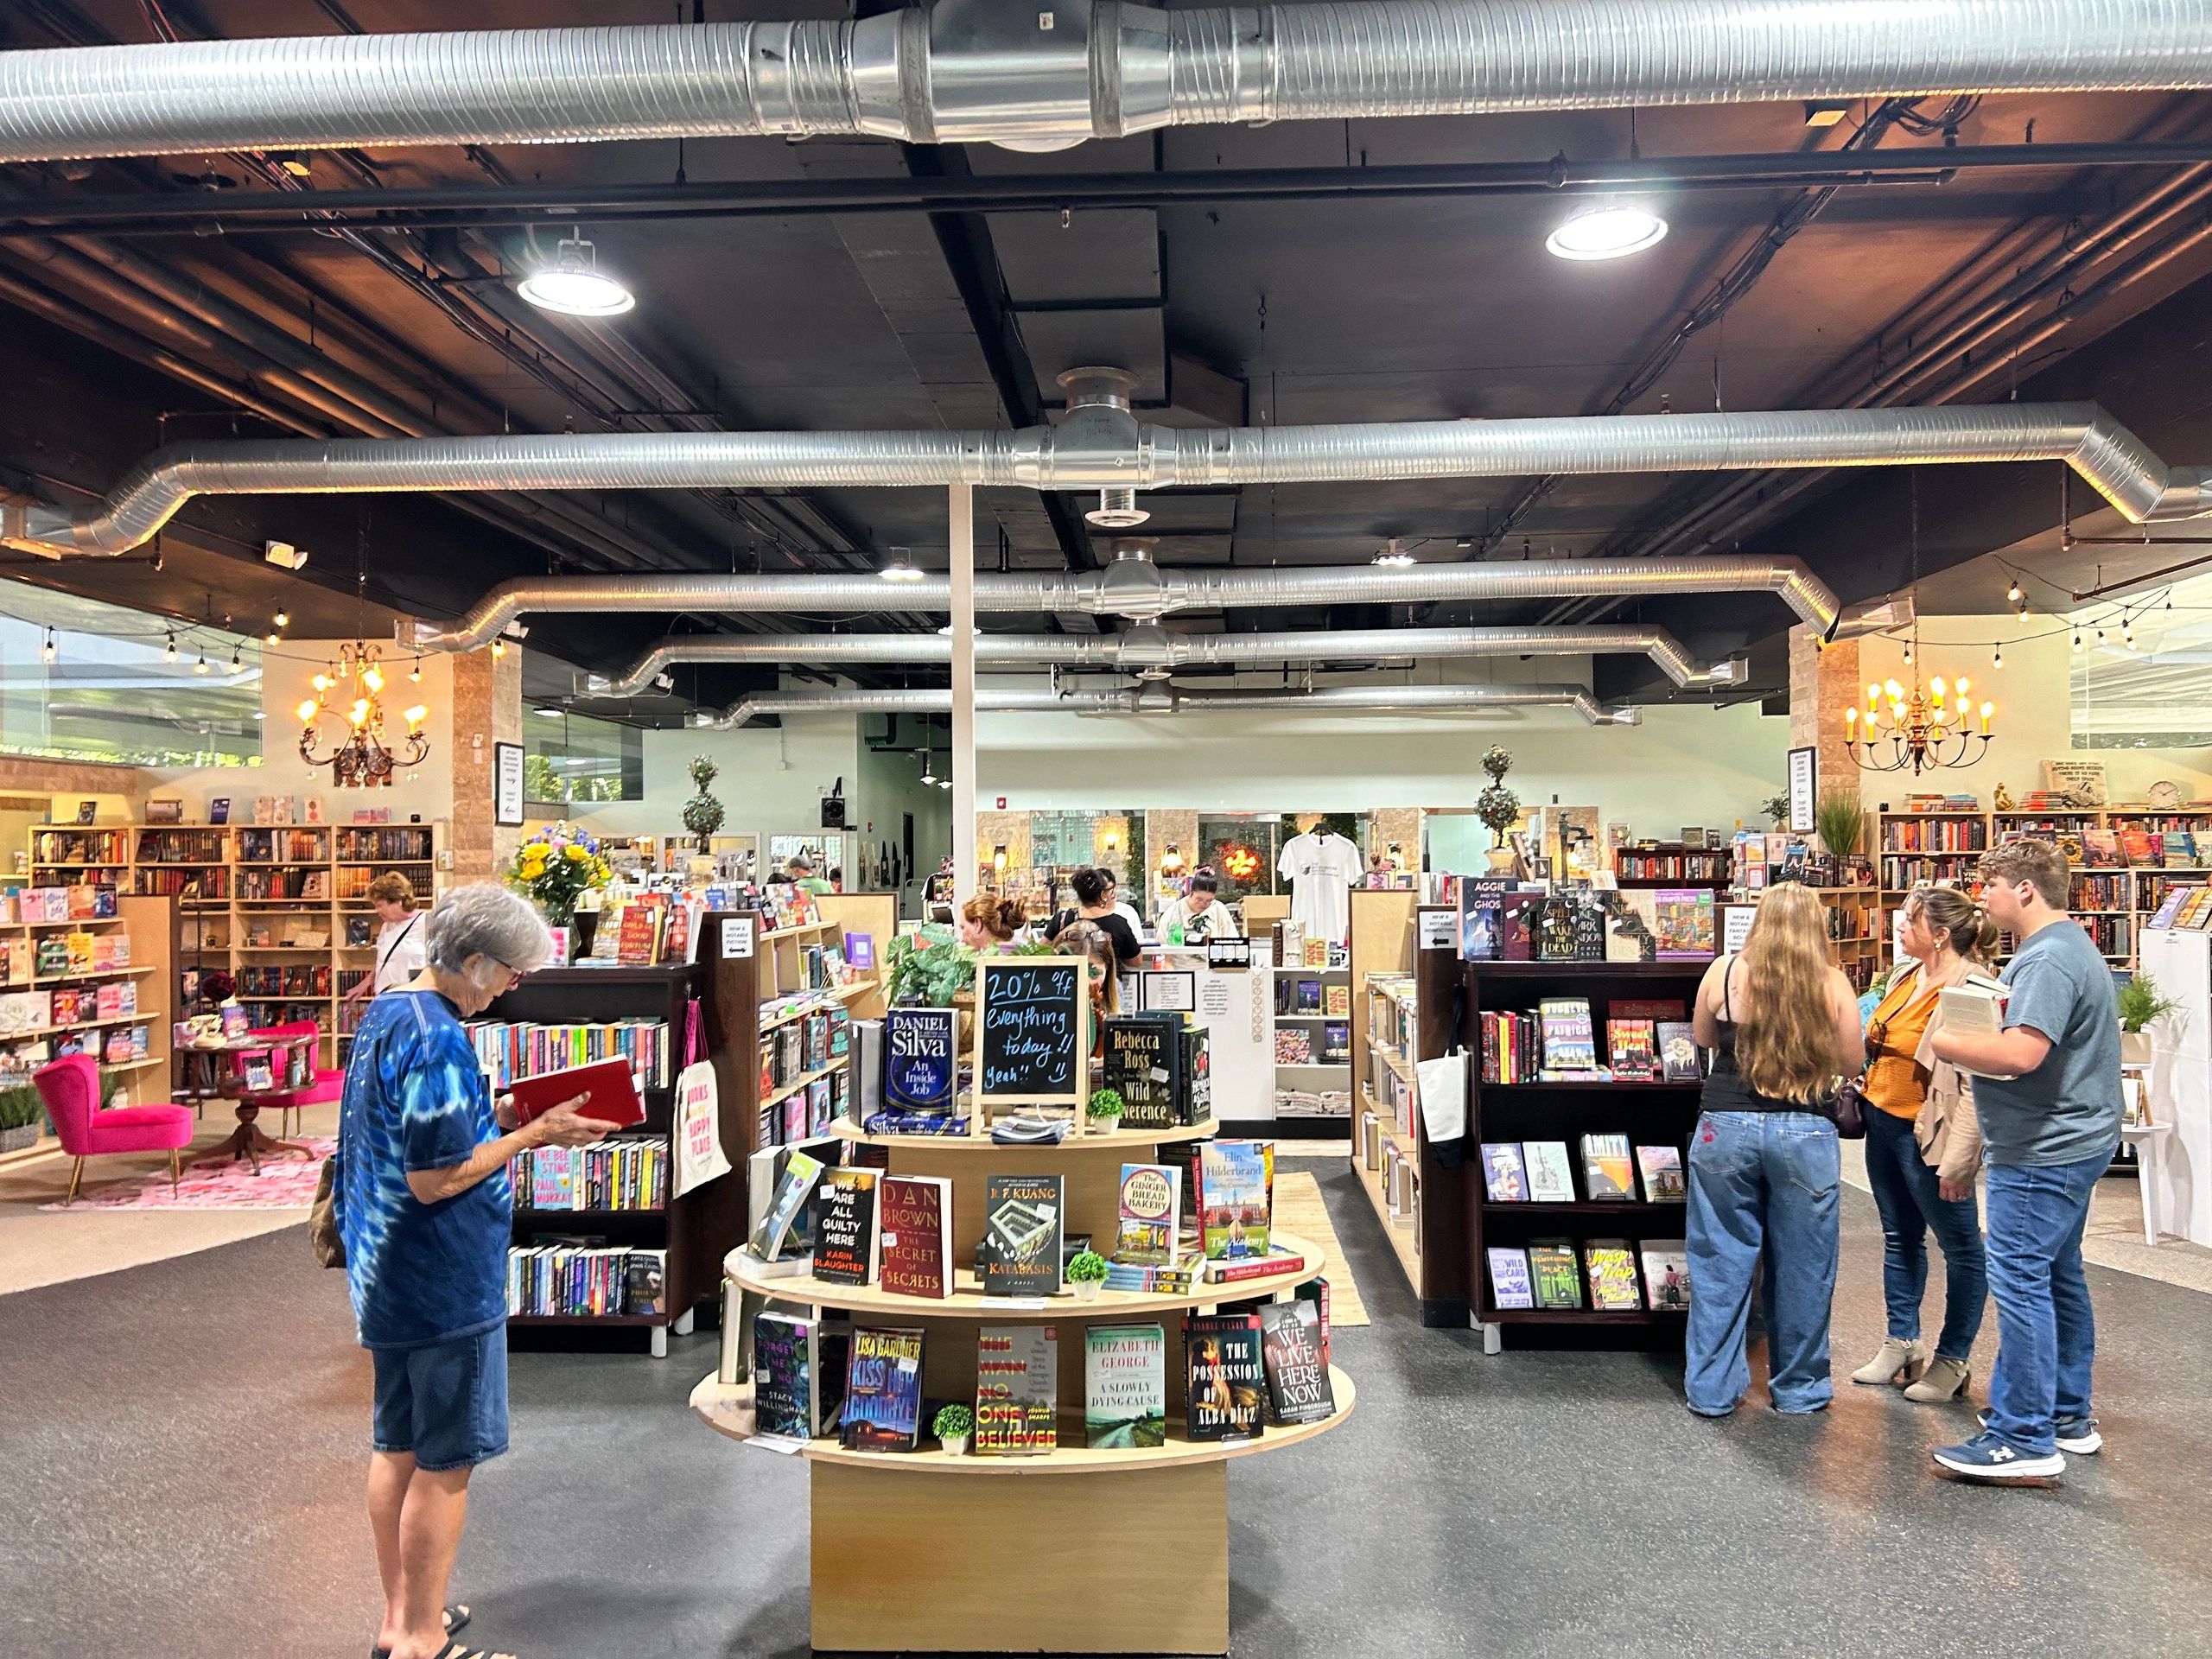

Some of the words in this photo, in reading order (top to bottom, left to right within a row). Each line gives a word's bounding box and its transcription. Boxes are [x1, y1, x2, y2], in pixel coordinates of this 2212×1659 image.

[1474, 881, 1506, 892] AGGIE
[1474, 900, 1502, 909] GHOS
[1547, 908, 1571, 918] SPELL
[1548, 925, 1573, 936] WAKE
[1578, 921, 1598, 932] ARK
[1306, 942, 1316, 965] BOOK
[1548, 943, 1573, 953] DEAD
[988, 969, 1041, 1001] 20%
[1051, 969, 1076, 998] off
[1329, 991, 1338, 1014] BOOK
[893, 1016, 948, 1031] DANIEL
[1548, 1024, 1588, 1036] PATRICK
[1114, 1030, 1160, 1050] Rebecca
[1613, 1028, 1649, 1039] Sweet
[892, 1028, 947, 1058] Silva
[1618, 1039, 1646, 1050] Heat
[1002, 1037, 1054, 1068] today
[1124, 1050, 1150, 1069] Ross
[912, 1060, 929, 1071] An
[905, 1071, 938, 1084] Inside
[910, 1084, 930, 1096] Job
[1125, 1082, 1150, 1101] Wild
[1123, 1104, 1166, 1120] verence
[1584, 1135, 1628, 1158] AMITY
[536, 1148, 551, 1160] THE
[553, 1148, 569, 1160] BEE
[1224, 1151, 1243, 1162] Elin
[542, 1162, 570, 1174] STING
[1206, 1165, 1262, 1177] Hilderbrand
[1142, 1173, 1158, 1182] The
[536, 1179, 556, 1191] PAUL
[835, 1180, 855, 1191] WE
[1130, 1180, 1166, 1192] GINGER
[535, 1192, 572, 1204] MURRAY
[831, 1192, 855, 1205] ARE
[882, 1183, 938, 1206] DAN
[1013, 1187, 1056, 1199] KUANG
[1132, 1190, 1165, 1201] BREAD
[831, 1205, 853, 1218] ALL
[1128, 1198, 1167, 1211] BAKERY
[882, 1207, 939, 1229] BROWN
[822, 1218, 861, 1233] GUILTY
[825, 1232, 855, 1246] HERE
[903, 1236, 918, 1245] THE
[1210, 1236, 1226, 1248] The
[1229, 1235, 1265, 1248] Academy
[825, 1249, 853, 1261] KARIN
[888, 1246, 937, 1262] SECRET
[1592, 1249, 1630, 1267] Wasp
[813, 1257, 865, 1273] SLAUGHTER
[989, 1262, 1054, 1275] KATABASIS
[1504, 1258, 1523, 1268] WILD
[1506, 1268, 1526, 1278] CARD
[1600, 1265, 1635, 1282] Trap
[980, 1336, 1013, 1352] THE
[1277, 1328, 1307, 1347] WE
[757, 1340, 794, 1355] FORGET
[855, 1337, 876, 1356] LISA
[877, 1338, 921, 1359] GARDNER
[1091, 1340, 1160, 1353] ELIZABETH
[1226, 1342, 1249, 1359] THE
[771, 1357, 785, 1368] ME
[1101, 1356, 1150, 1369] GEORGE
[1276, 1345, 1315, 1367] LIVE
[852, 1358, 886, 1387] KISS
[979, 1359, 1026, 1376] MAN
[1192, 1363, 1259, 1382] POSSESSION
[887, 1367, 918, 1394] HER
[1277, 1364, 1321, 1387] HERE
[978, 1382, 1010, 1400] NO
[1100, 1382, 1106, 1394] A
[1109, 1382, 1151, 1394] SLOWLY
[1203, 1387, 1217, 1402] OF
[1282, 1383, 1321, 1406] NOW
[768, 1390, 792, 1402] STACY
[1091, 1395, 1124, 1408] DYING
[1127, 1394, 1160, 1407] CAUSE
[757, 1398, 806, 1414] WILLINGHAM
[850, 1395, 915, 1421] GOODBYE
[977, 1406, 1021, 1425] ONE
[1198, 1408, 1226, 1426] ALBA
[1230, 1404, 1256, 1424] DÍAZ
[977, 1430, 1057, 1448] BELIEVED
